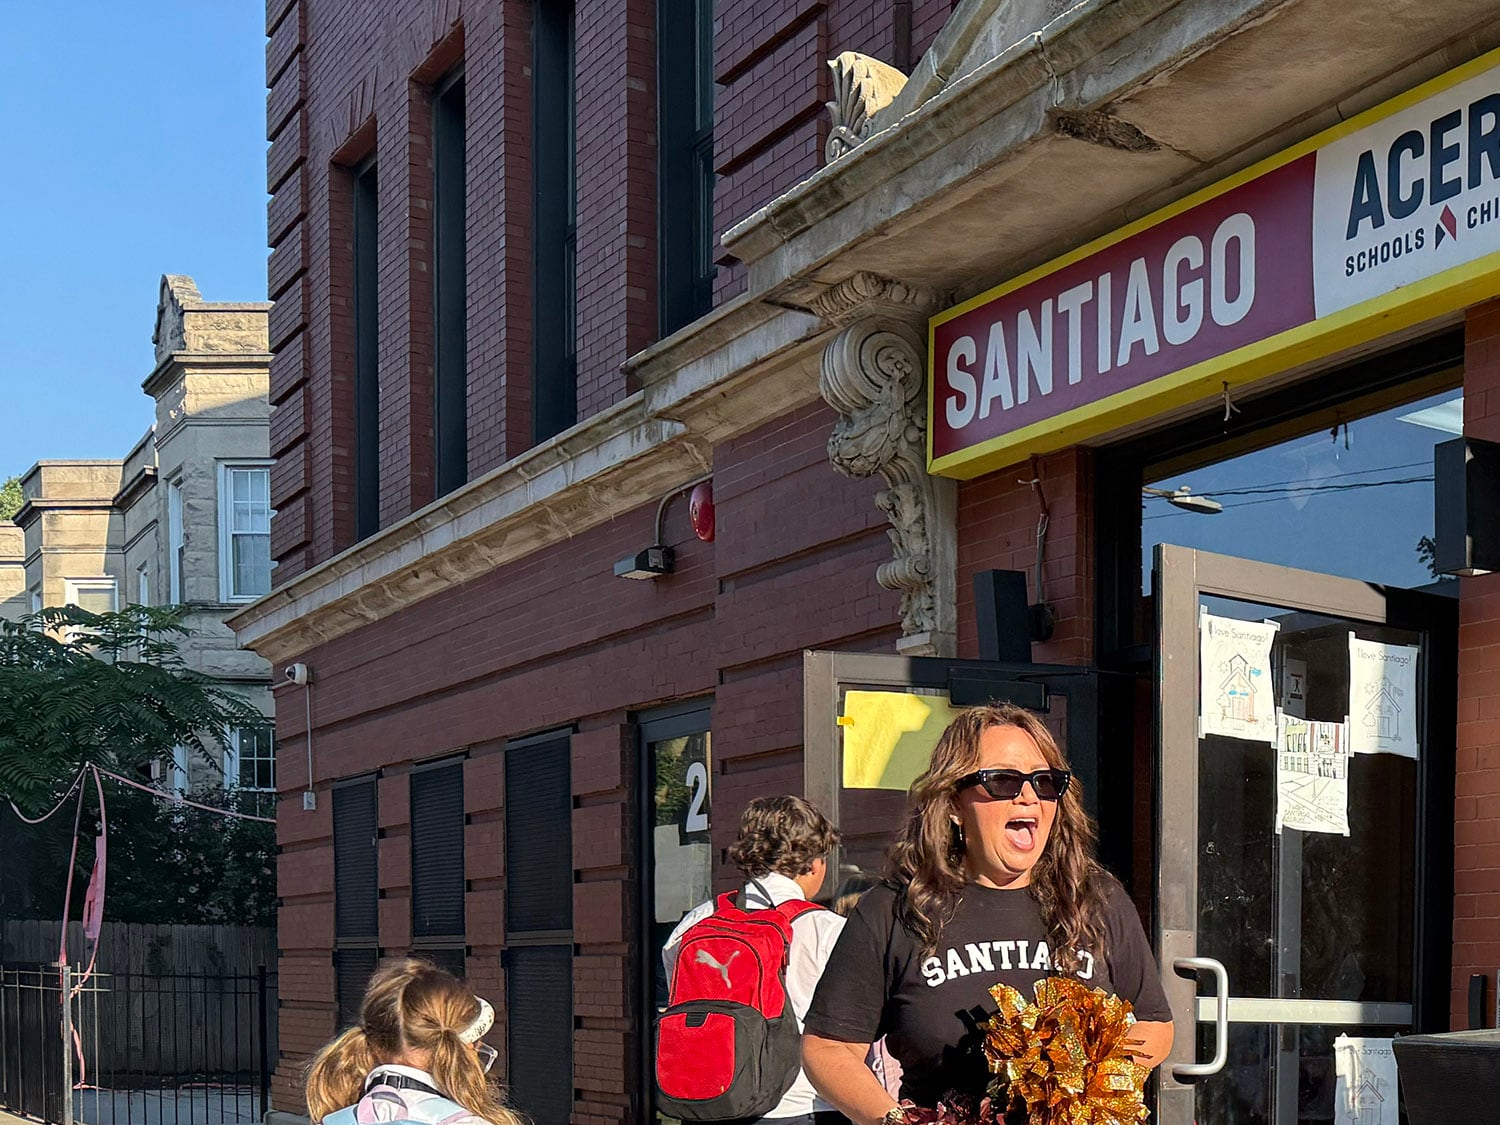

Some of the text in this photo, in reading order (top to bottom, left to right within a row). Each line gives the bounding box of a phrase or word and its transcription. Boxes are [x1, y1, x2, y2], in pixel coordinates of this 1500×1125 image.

[1344, 227, 1425, 277] SCHOOLS
[945, 212, 1256, 430] SANTIAGO
[686, 761, 708, 832] 2
[920, 940, 1094, 988] SANTIAO
